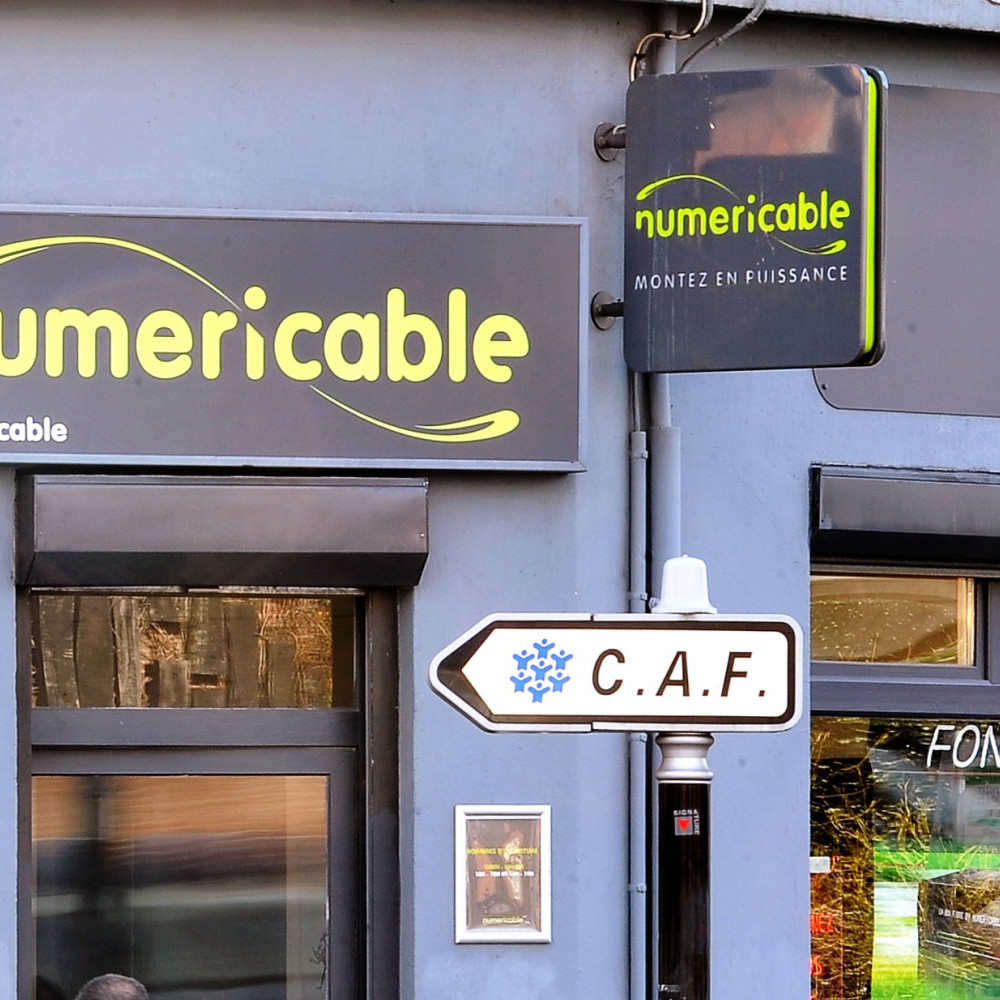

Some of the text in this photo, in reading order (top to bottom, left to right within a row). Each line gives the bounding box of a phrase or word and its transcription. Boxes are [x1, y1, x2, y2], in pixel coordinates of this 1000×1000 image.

[635, 190, 850, 238] numericable
[634, 265, 848, 290] MONTEZ EN PUISSANCE
